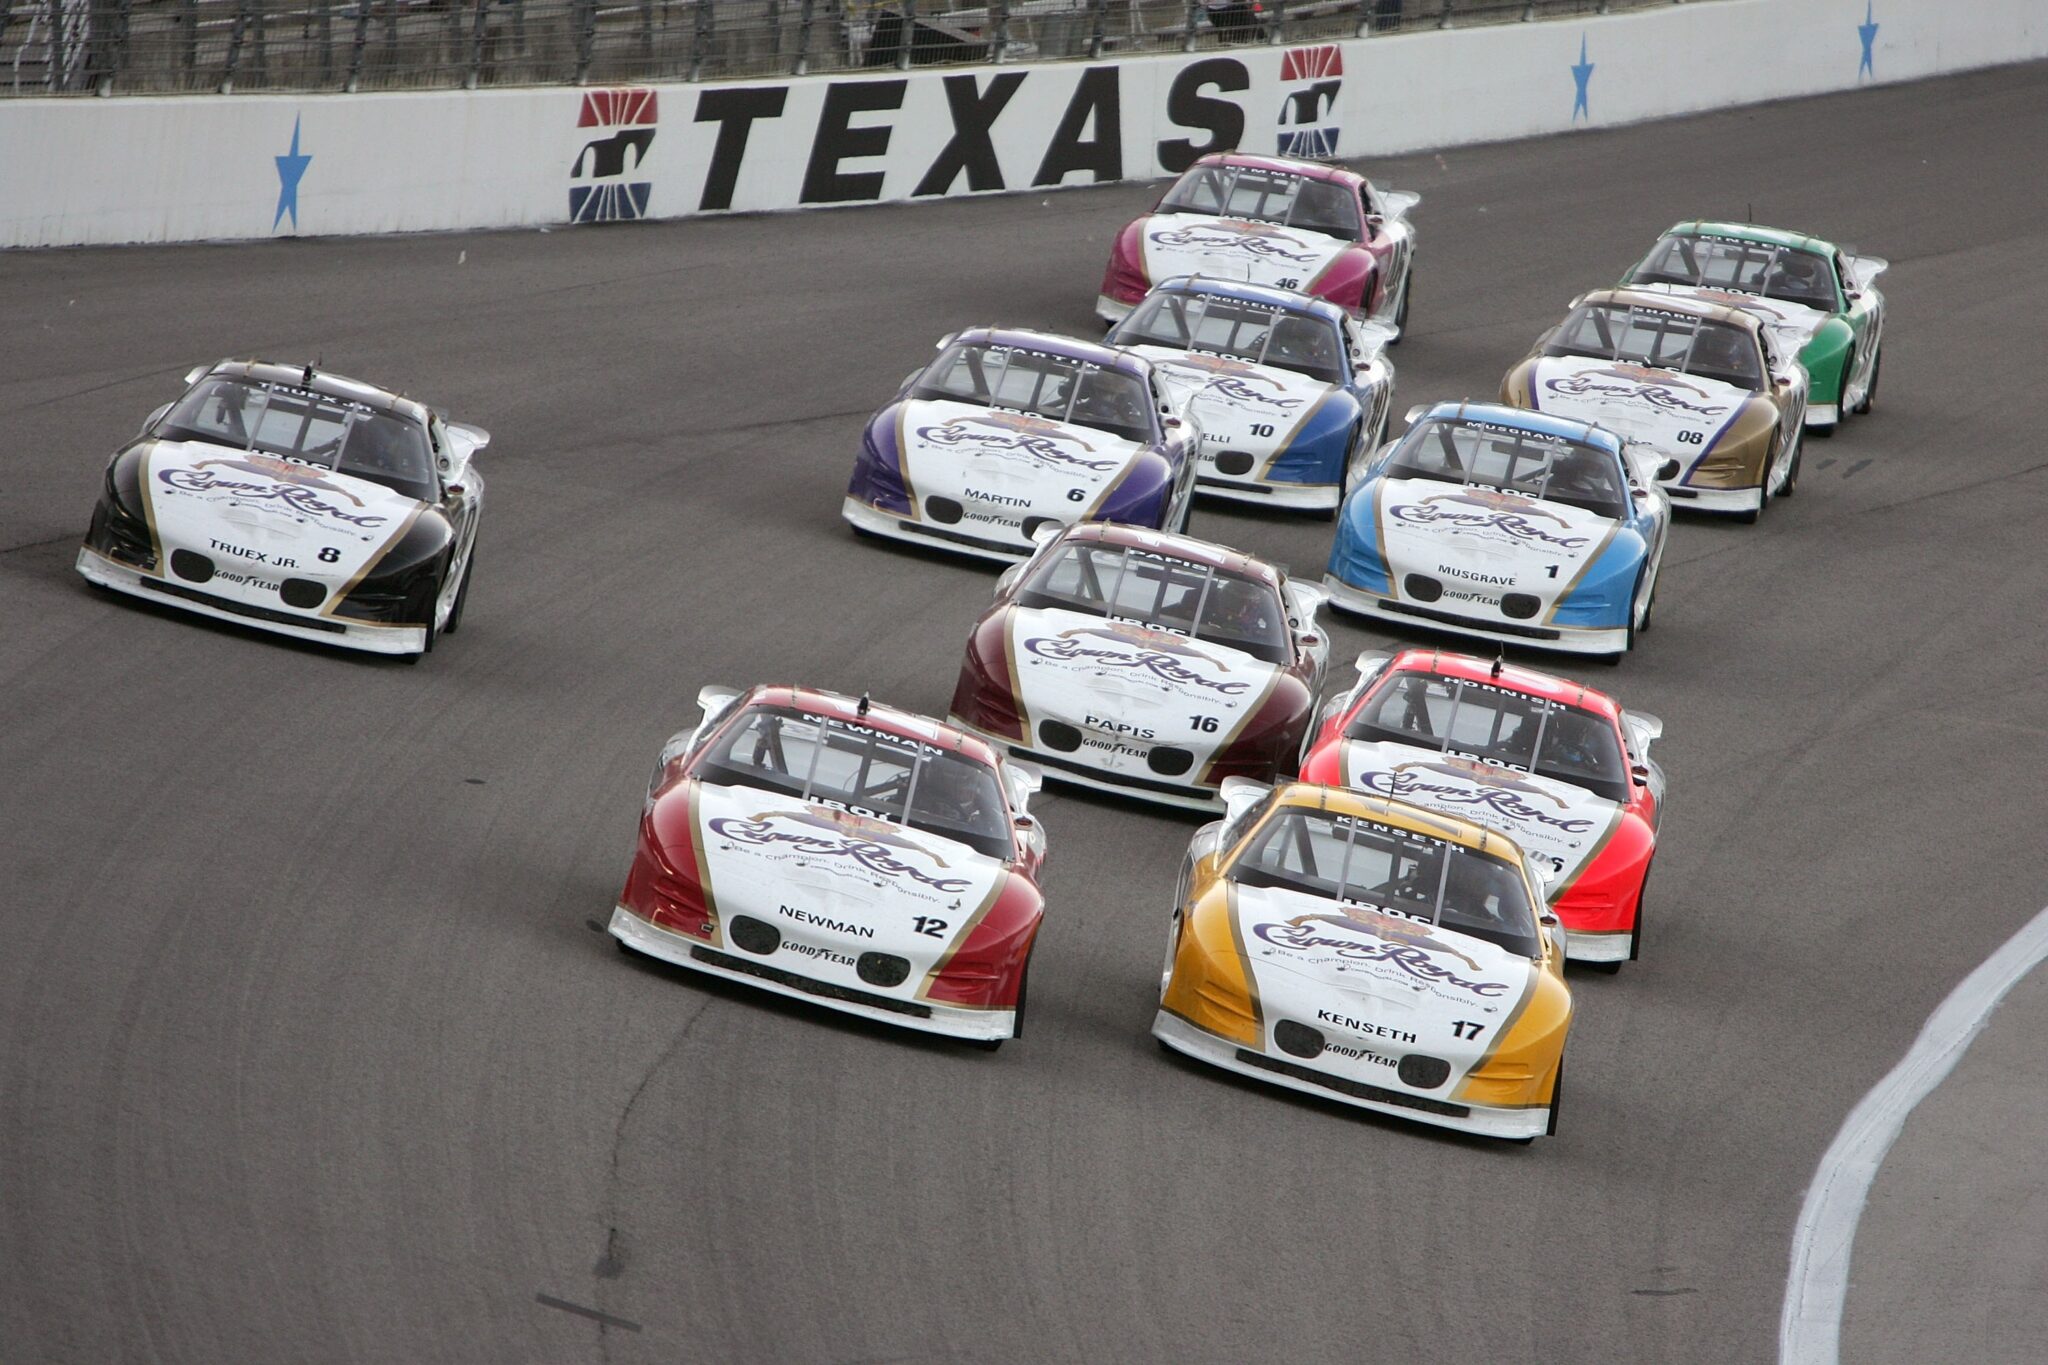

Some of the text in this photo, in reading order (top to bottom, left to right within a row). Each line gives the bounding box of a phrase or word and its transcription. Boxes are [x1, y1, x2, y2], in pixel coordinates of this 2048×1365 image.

[693, 57, 1250, 210] TEXAS
[1275, 277, 1299, 290] 46
[990, 345, 1100, 370] MARTIN
[258, 382, 337, 404] TRUEX
[1603, 384, 1728, 416] Royal
[1248, 423, 1275, 438] 10
[1466, 421, 1568, 444] MUSGRAVE
[1676, 430, 1704, 445] 08
[981, 434, 1120, 471] Royal
[231, 483, 389, 528] Royal
[964, 487, 1032, 508] MARTIN
[1066, 488, 1087, 502] 6
[1453, 512, 1591, 549] Royal
[209, 537, 300, 569] TRUEX JR.
[317, 546, 341, 564] 8
[1130, 549, 1208, 572] PAPIS
[1437, 564, 1517, 586] MUSGRAVE
[1544, 564, 1560, 579] 1
[1099, 652, 1251, 696] Royal
[1443, 676, 1566, 711] HORNISH
[803, 713, 944, 756] NEWMAN
[1084, 714, 1155, 739] PAPIS
[1189, 715, 1220, 734] 16
[1434, 787, 1595, 834] Royal
[1336, 815, 1465, 854] KENSETH
[793, 838, 973, 893] Royal
[779, 904, 875, 939] NEWMAN
[912, 915, 949, 940] 12
[1278, 949, 1293, 958] Be
[1374, 966, 1406, 979] Drink
[1336, 942, 1510, 997] Royal
[1317, 1009, 1417, 1044] KENSETH
[1451, 1020, 1486, 1041] 17
